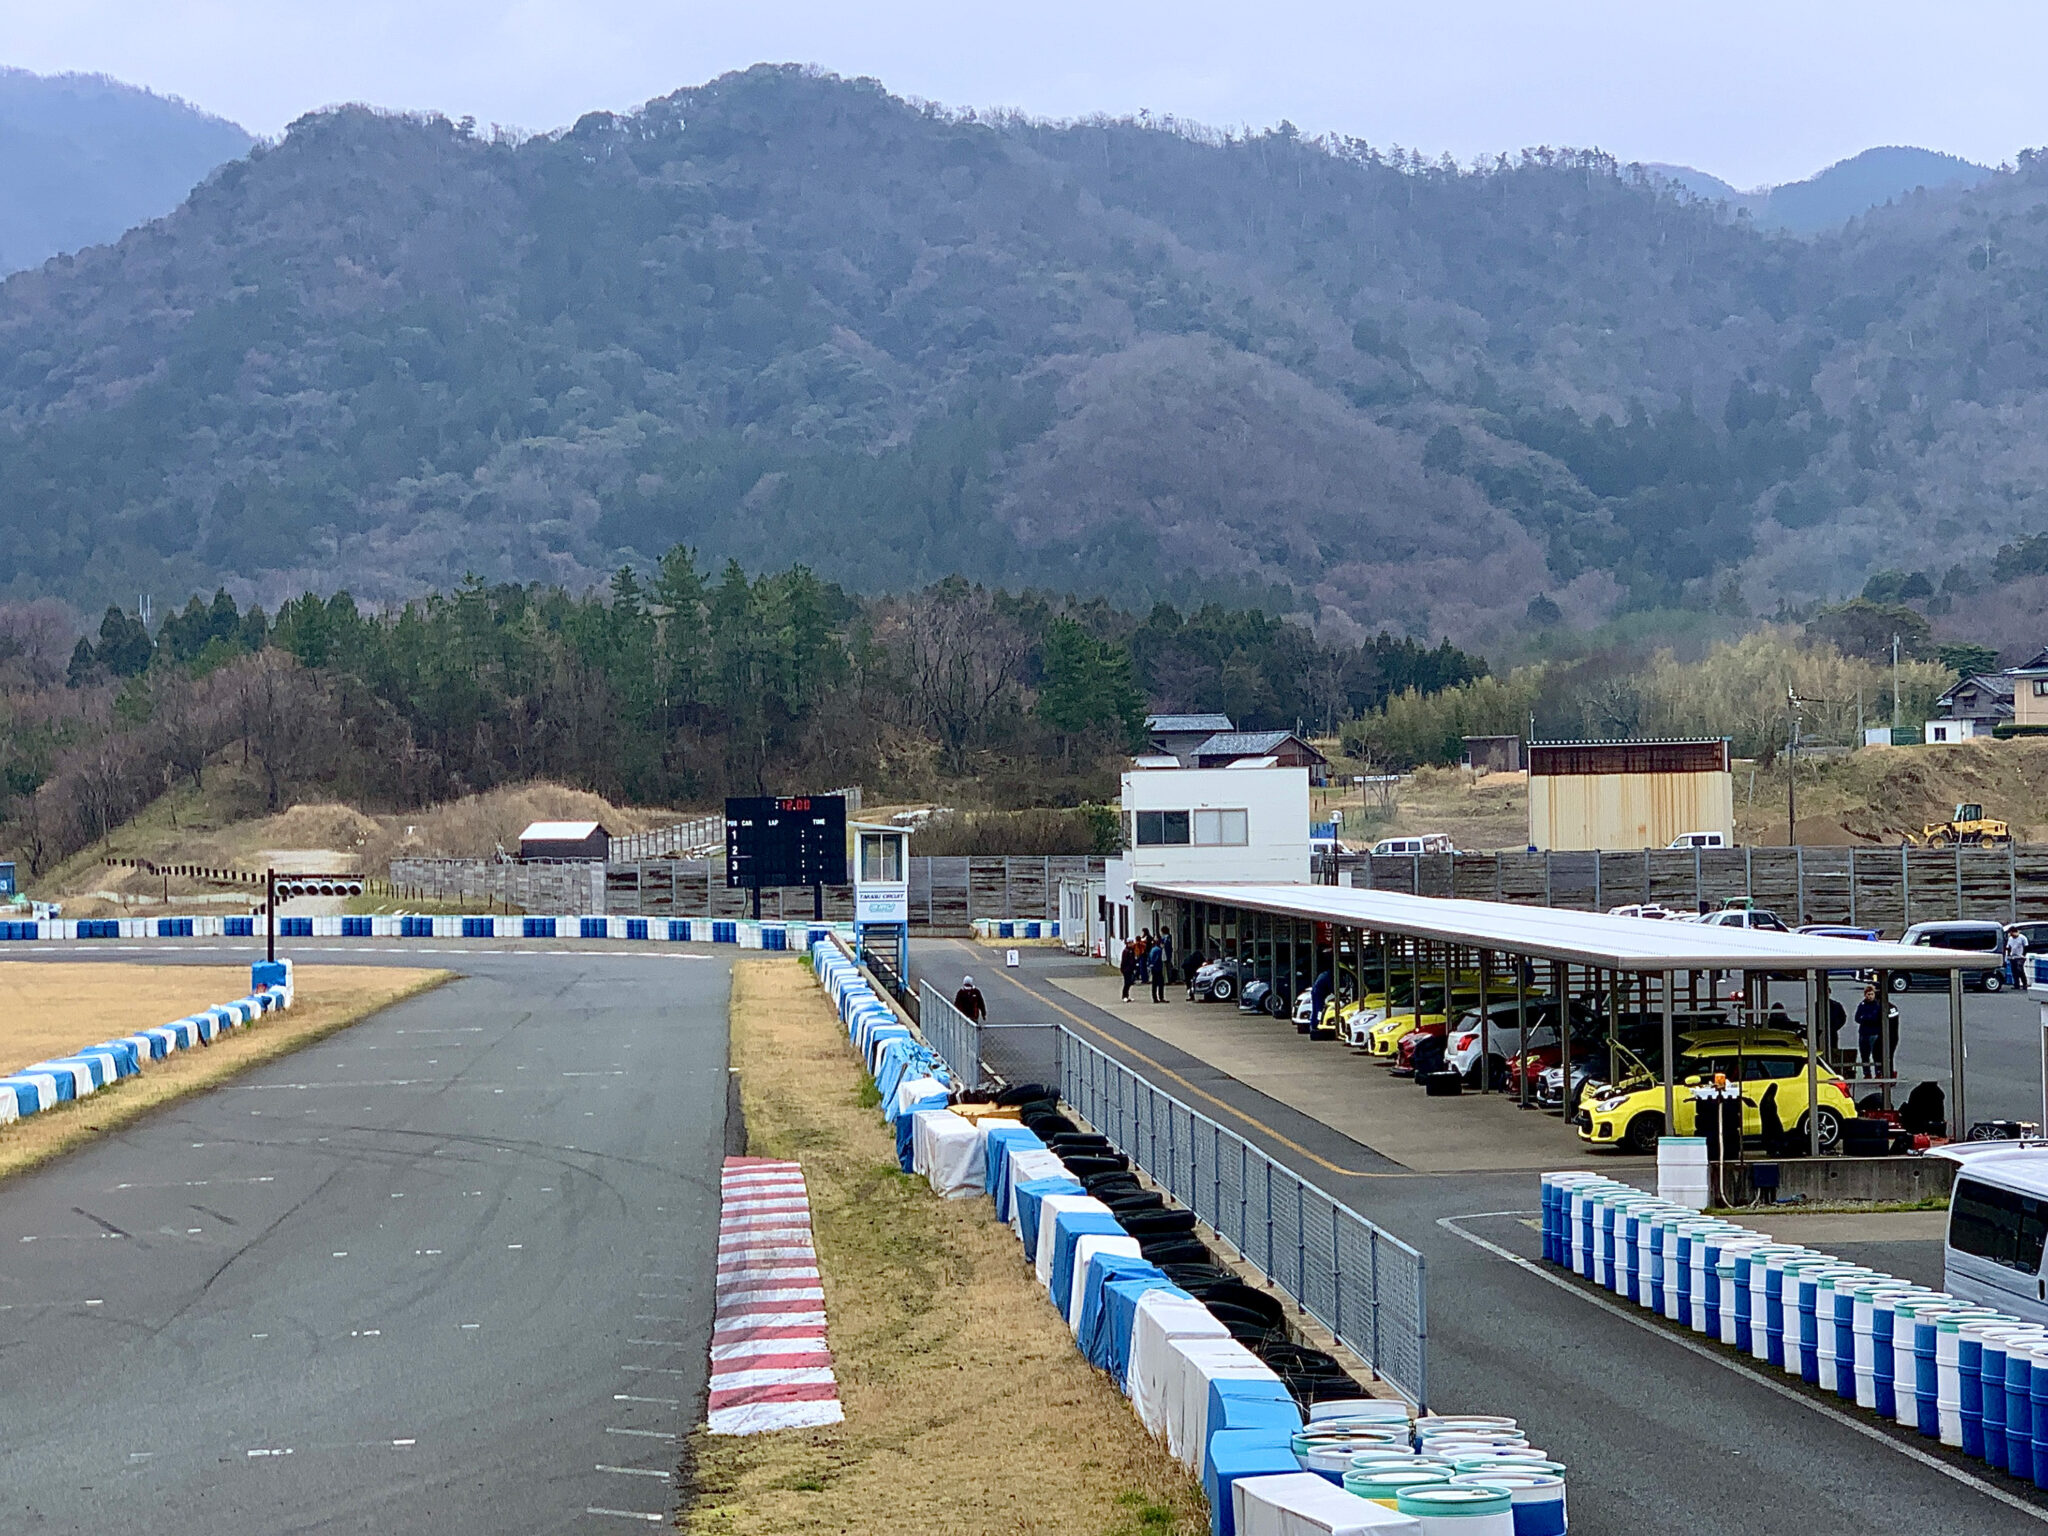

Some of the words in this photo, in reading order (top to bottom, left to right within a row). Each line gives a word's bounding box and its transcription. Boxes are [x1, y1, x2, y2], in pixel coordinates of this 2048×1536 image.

[732, 830, 737, 840] 1
[732, 846, 738, 855] 2
[732, 861, 738, 870] 3
